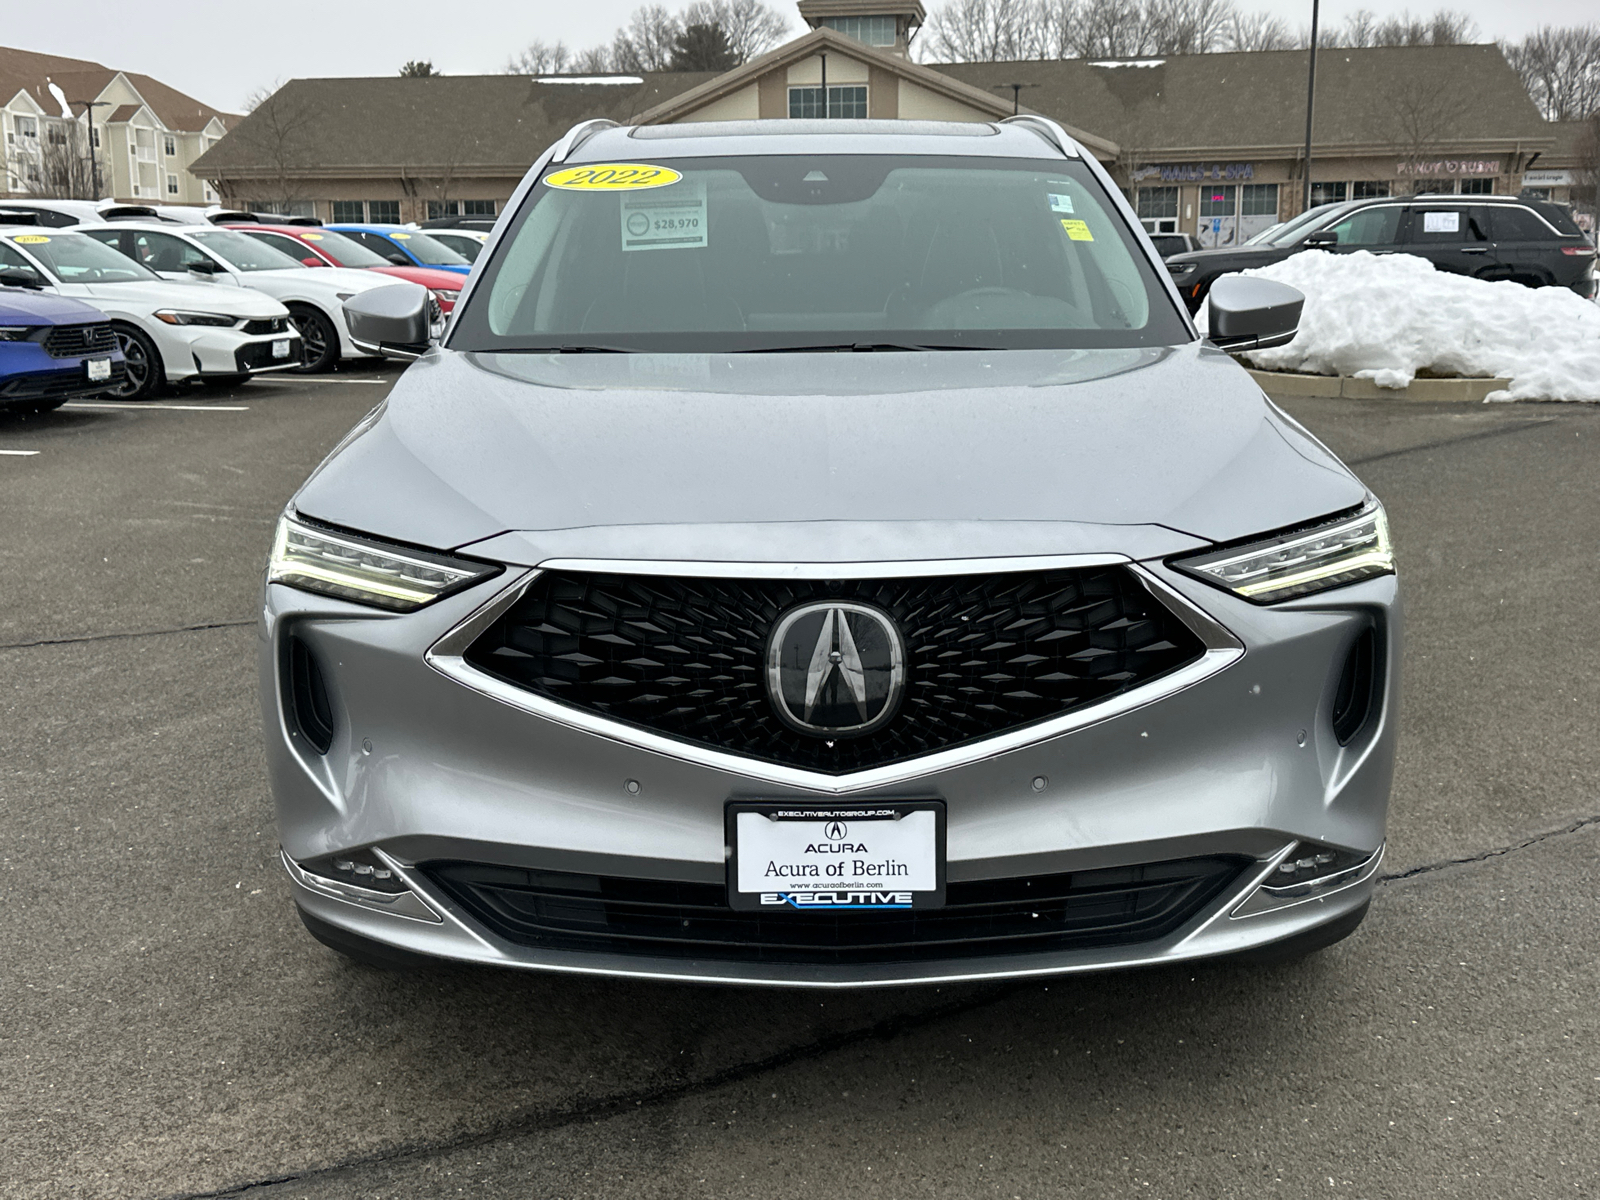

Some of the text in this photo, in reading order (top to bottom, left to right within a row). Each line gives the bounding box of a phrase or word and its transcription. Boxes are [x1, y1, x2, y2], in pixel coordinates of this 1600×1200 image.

[563, 169, 661, 186] 2022
[1160, 164, 1205, 181] NAILS
[1211, 164, 1221, 179] &
[1225, 163, 1254, 179] SPA
[654, 217, 699, 231] $28,970
[777, 809, 895, 818] EXECUTIVEAUTOGROUP.COM
[804, 843, 868, 853] ACURA
[764, 859, 909, 877] Acura of Berlin
[760, 891, 913, 906] EXECUTIVE
